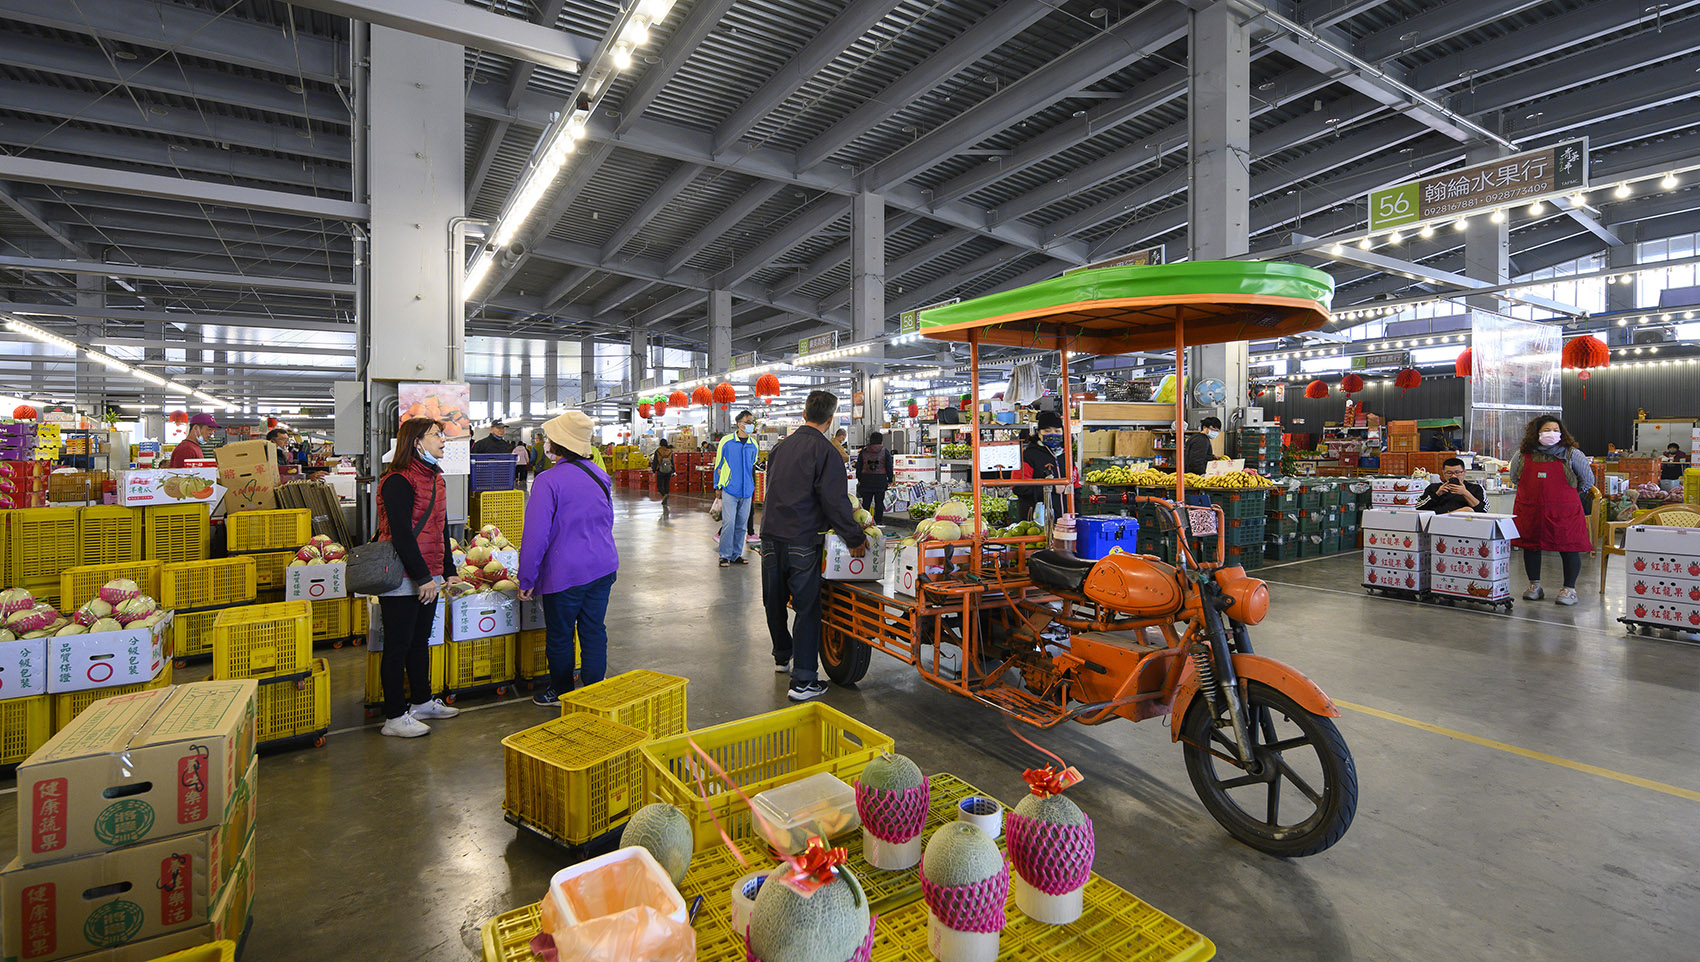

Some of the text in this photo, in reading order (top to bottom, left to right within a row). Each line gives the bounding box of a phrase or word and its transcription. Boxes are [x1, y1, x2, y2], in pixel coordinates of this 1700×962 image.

[1425, 156, 1548, 204] 翰綸水果行
[1379, 192, 1410, 217] 56
[1424, 182, 1548, 217] 0928167881 0928773409
[903, 315, 914, 328] 58
[232, 485, 269, 497] TAIWAN
[1451, 545, 1475, 557] 紅龍果
[1450, 563, 1474, 575] 紅龍果
[1650, 561, 1683, 574] 紅龍果
[1651, 585, 1684, 598] 紅龍果
[1650, 609, 1683, 622] 紅龍果
[19, 648, 32, 689] 分級包裝
[59, 642, 72, 683] 品質保證
[128, 636, 140, 676] 分級包裝
[39, 780, 62, 851] 健康蔬果
[27, 886, 50, 955] 健康蔬果
